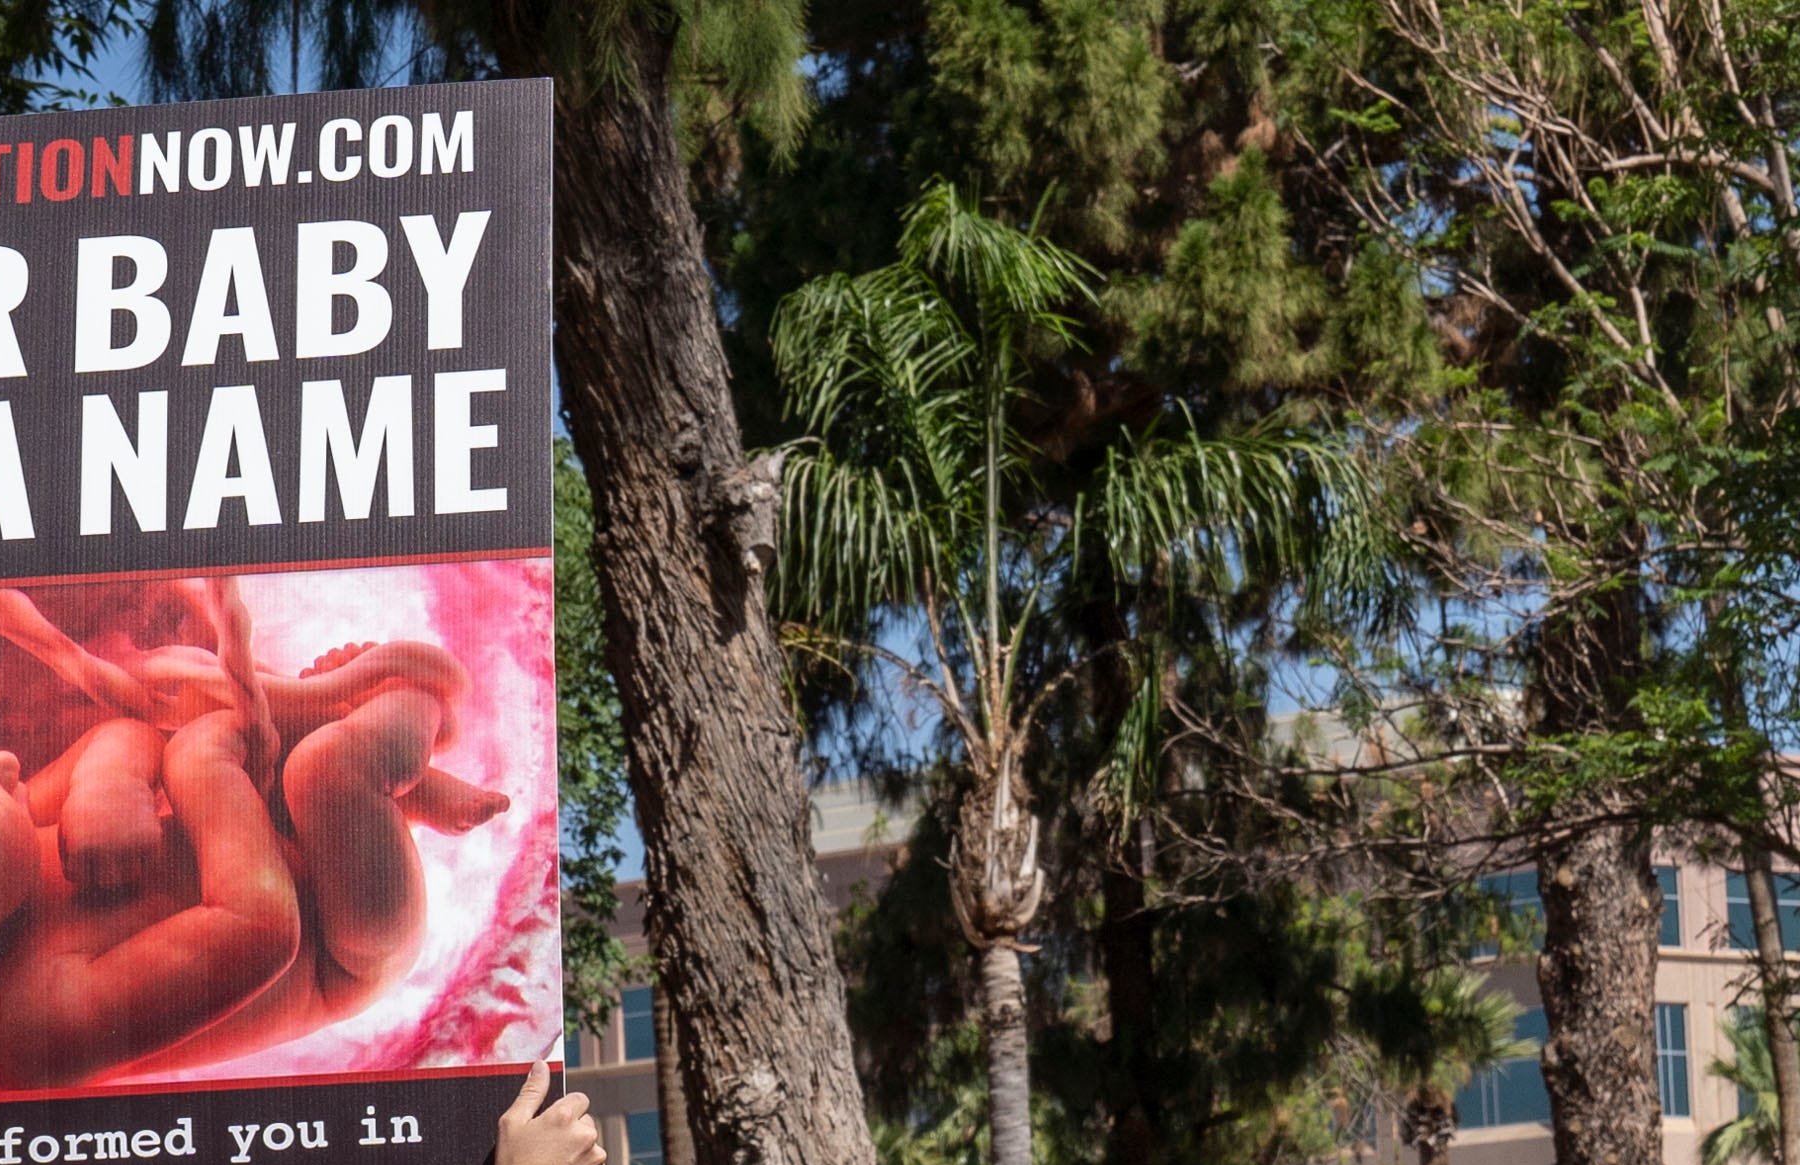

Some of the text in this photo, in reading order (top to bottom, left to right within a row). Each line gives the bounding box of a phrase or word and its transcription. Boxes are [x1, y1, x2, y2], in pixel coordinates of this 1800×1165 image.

[75, 210, 492, 374] BABY
[79, 368, 507, 536] NAME
[227, 1120, 329, 1164] you
[358, 1105, 423, 1146] in
